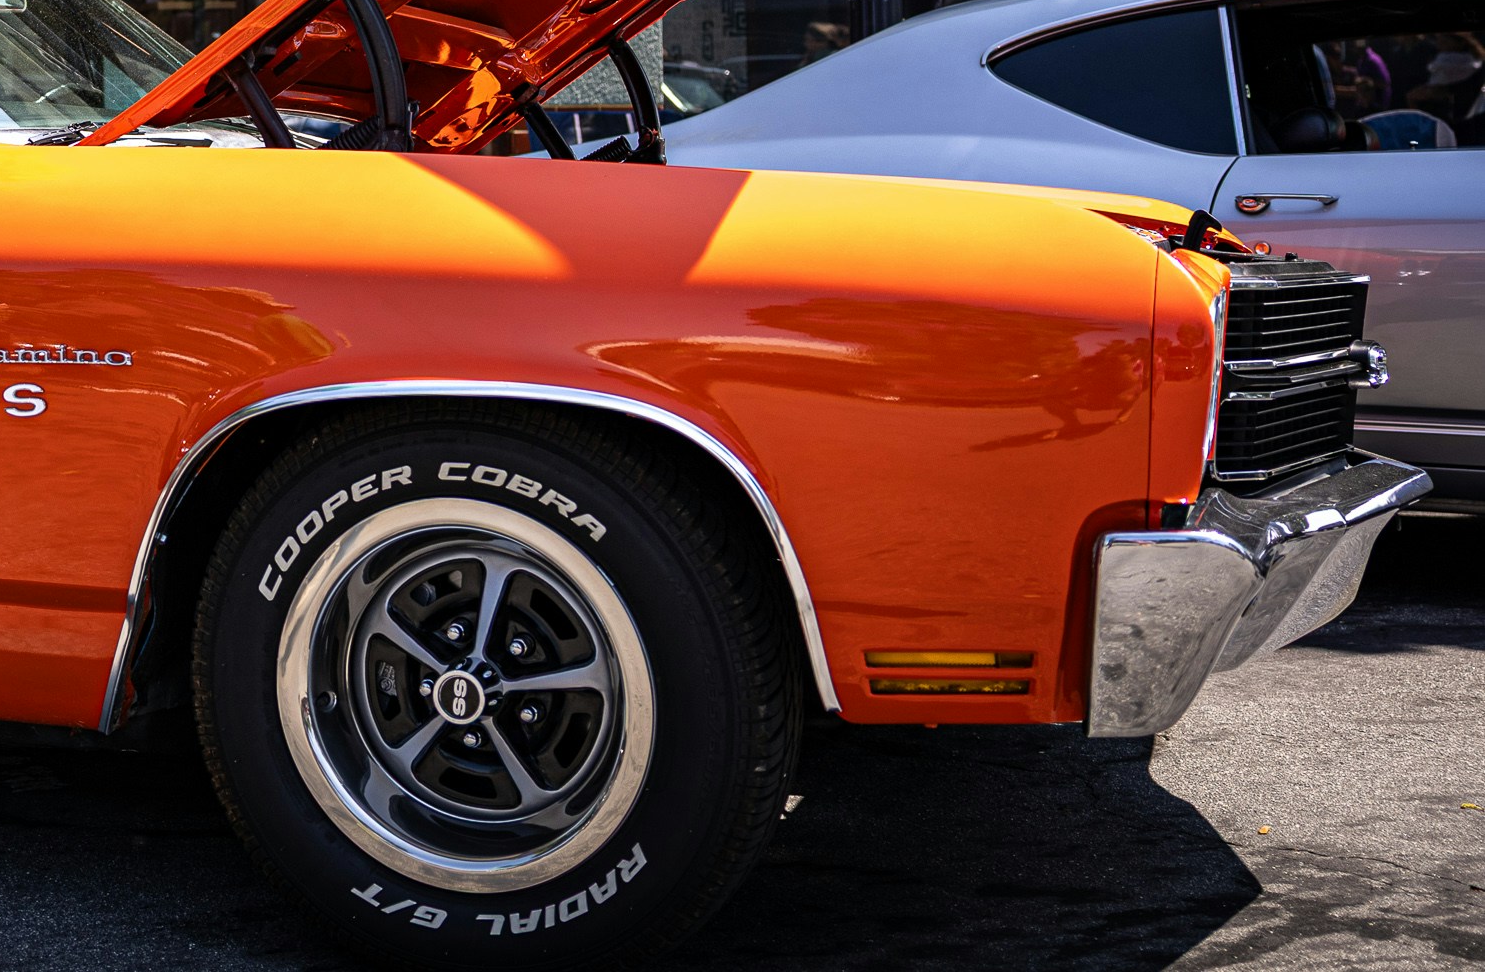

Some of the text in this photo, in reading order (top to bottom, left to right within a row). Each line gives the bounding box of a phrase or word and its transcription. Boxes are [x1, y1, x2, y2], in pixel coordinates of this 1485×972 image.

[258, 461, 607, 602] COOPER COBRA
[452, 679, 467, 717] SS
[351, 842, 648, 936] RADIAL G/T
